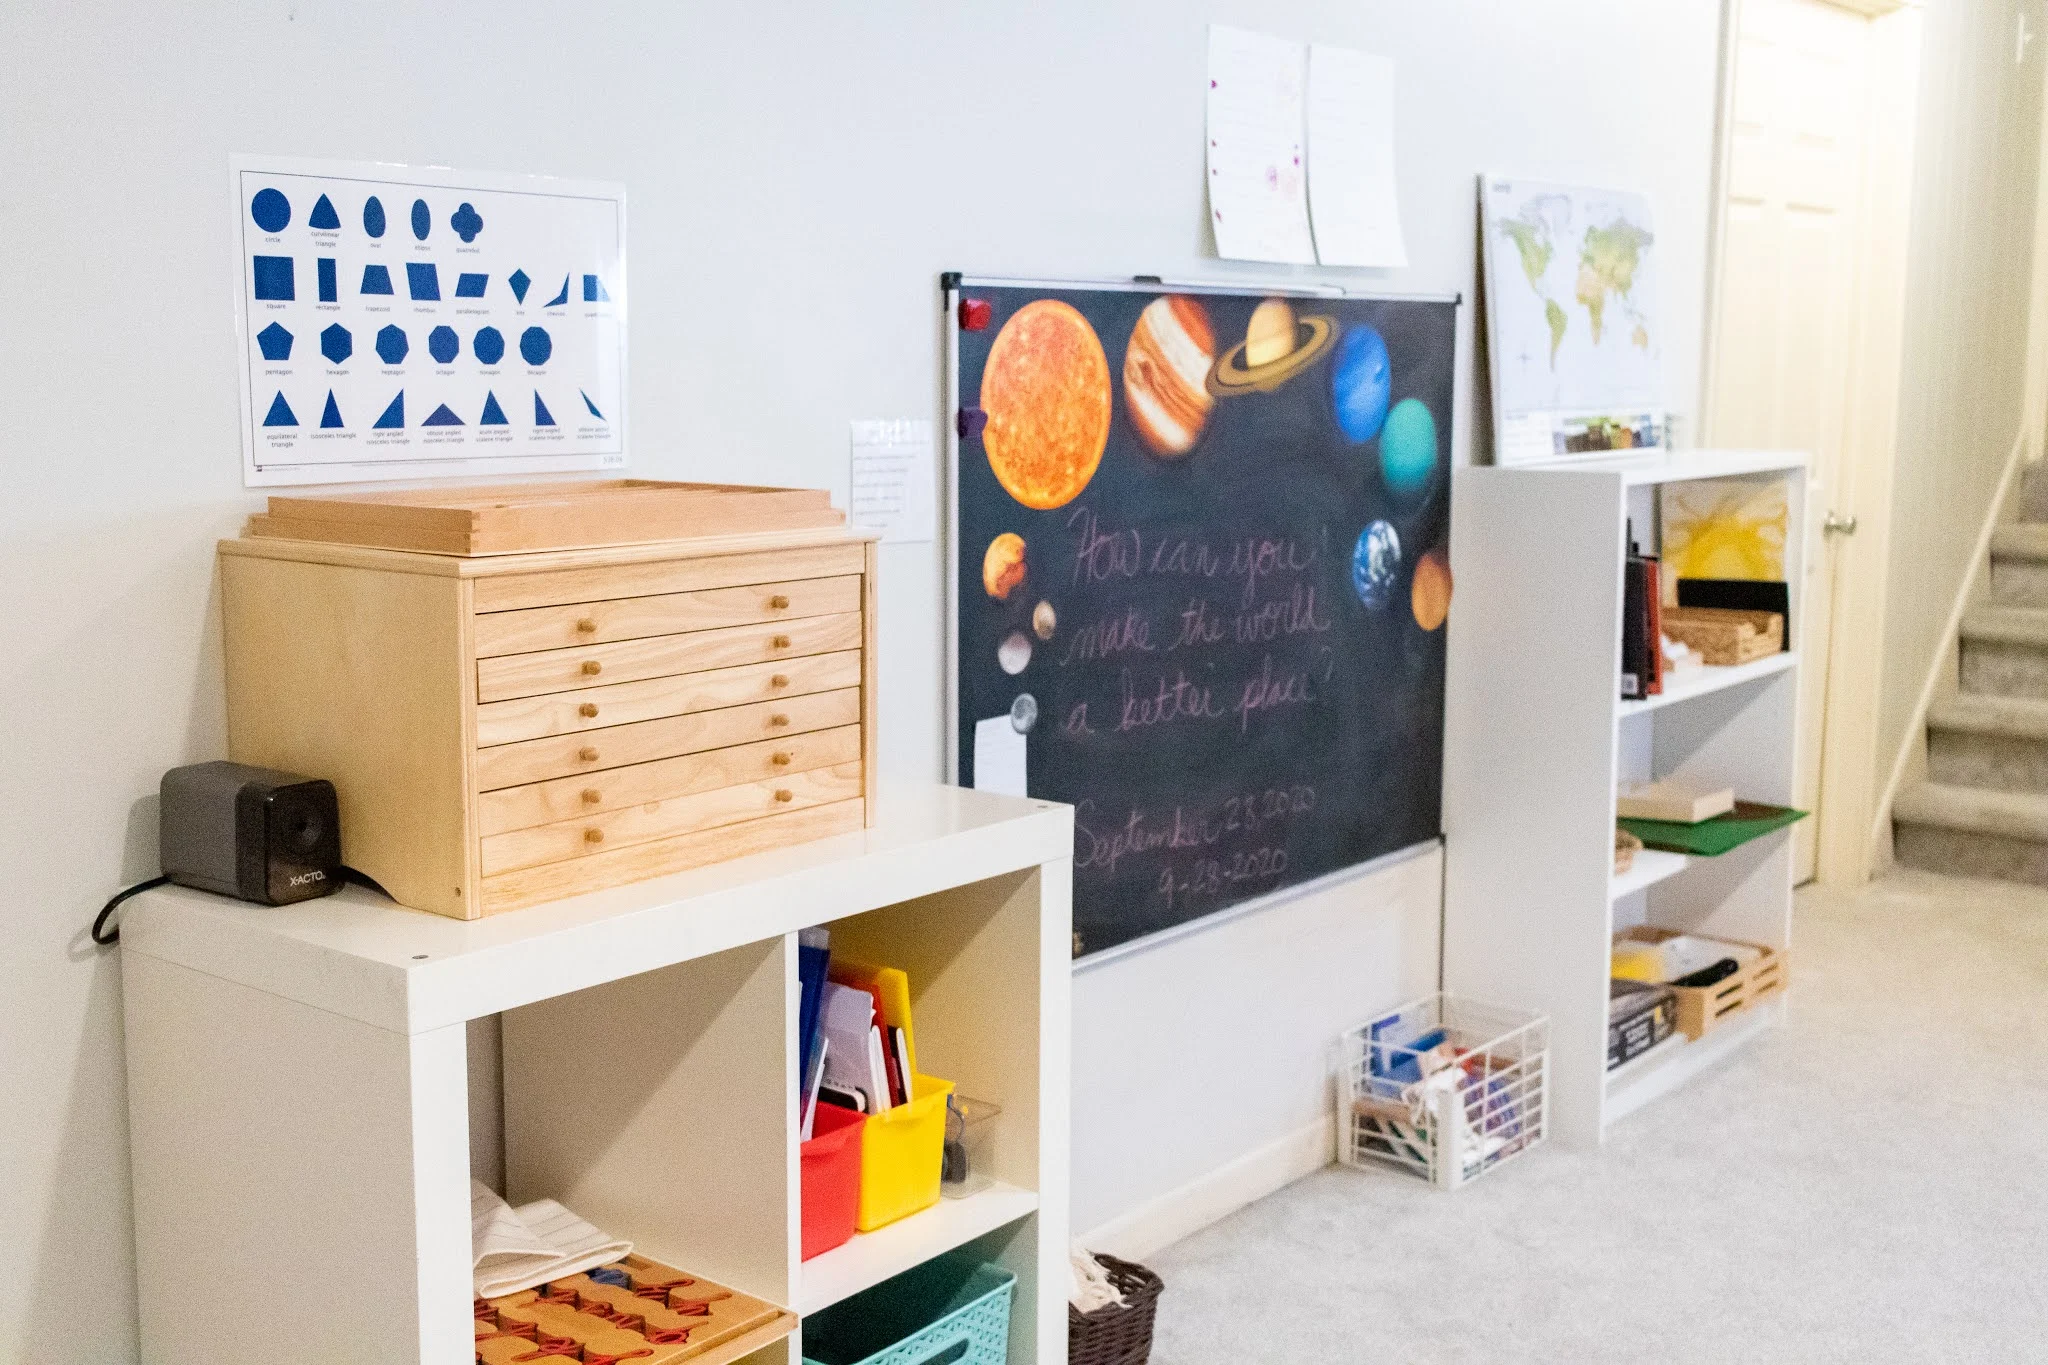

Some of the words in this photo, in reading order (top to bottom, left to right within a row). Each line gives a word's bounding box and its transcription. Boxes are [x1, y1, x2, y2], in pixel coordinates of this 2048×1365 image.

[1067, 505, 1141, 587] How
[1150, 536, 1219, 577] can
[1060, 606, 1156, 666] make
[1167, 599, 1226, 653] the
[1235, 582, 1331, 643] world
[1061, 702, 1096, 735] a
[1112, 667, 1226, 732] better
